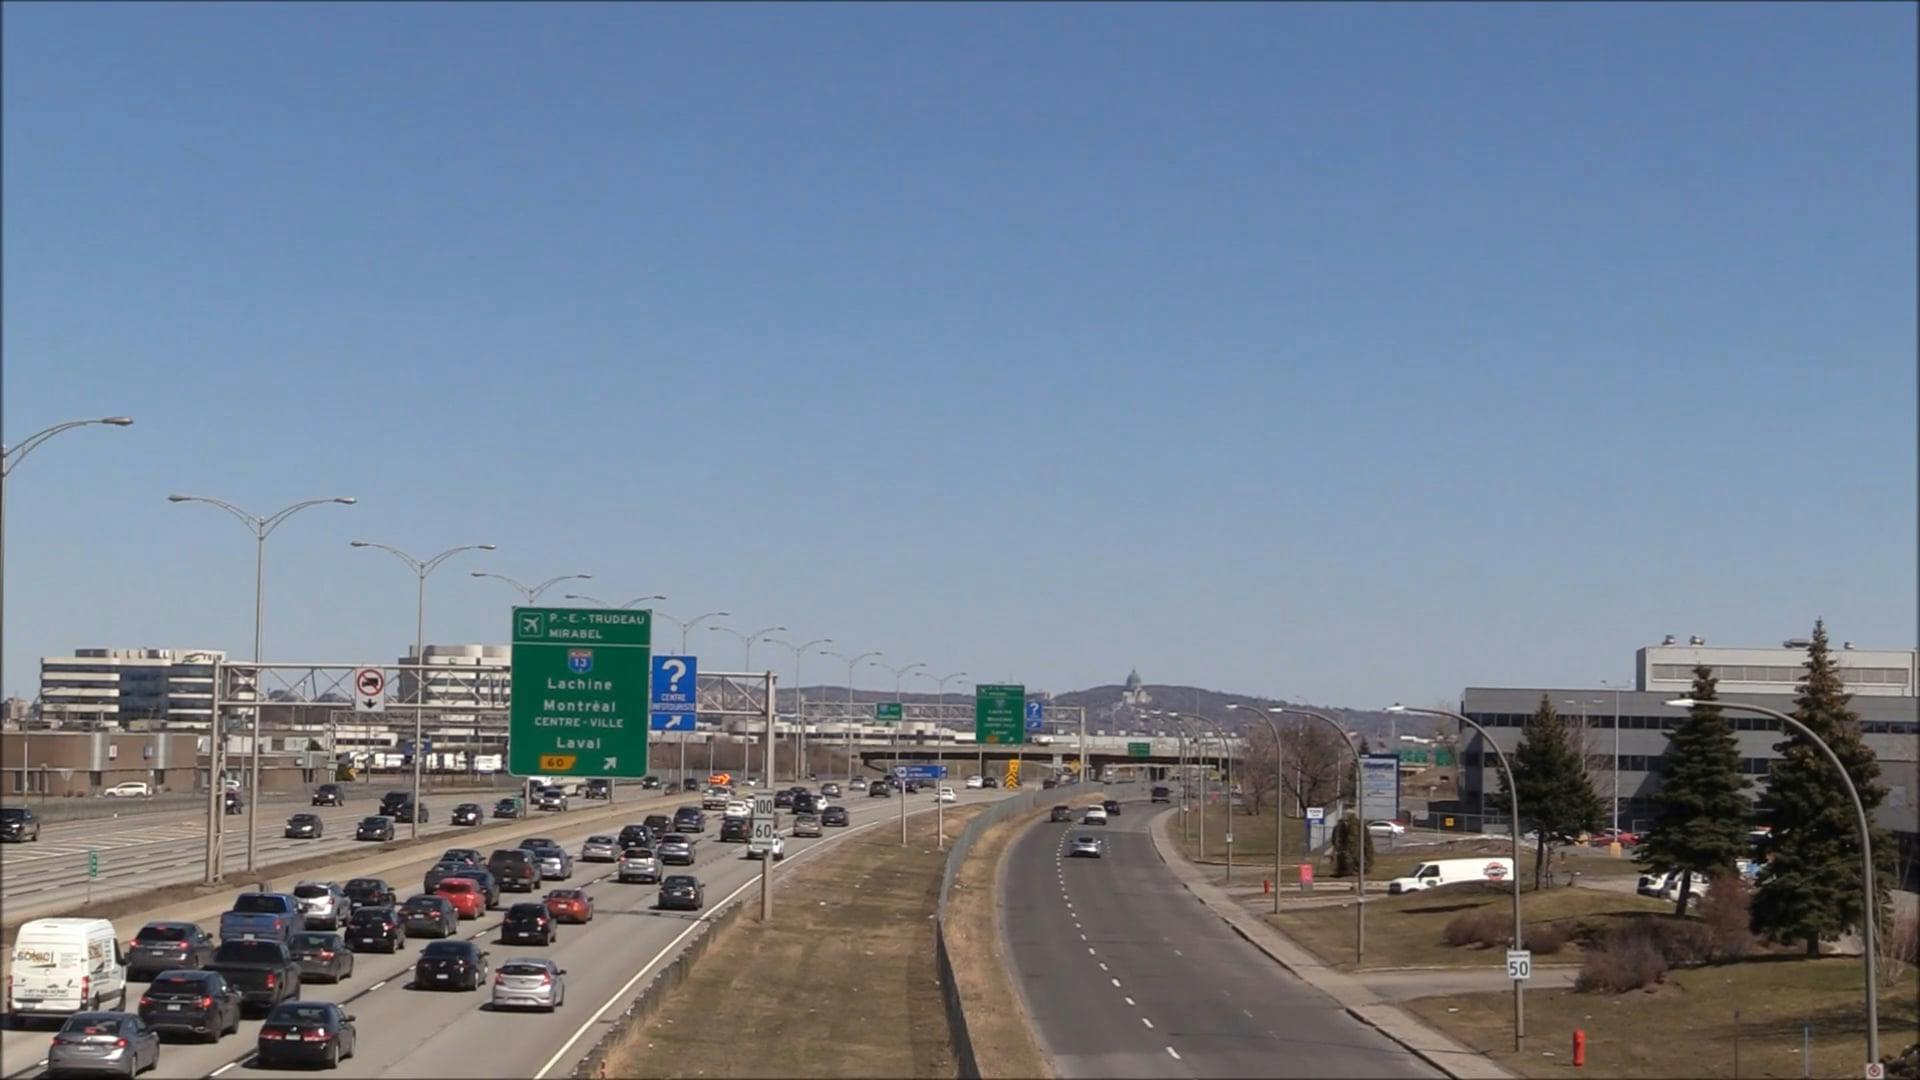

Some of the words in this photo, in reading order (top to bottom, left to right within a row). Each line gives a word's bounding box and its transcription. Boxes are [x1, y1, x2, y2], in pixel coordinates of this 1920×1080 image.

[549, 629, 603, 639] MIRABEL
[574, 658, 587, 668] 13
[547, 677, 612, 690] Lachine
[543, 699, 616, 712] Montréal
[556, 737, 601, 749] Laval
[547, 758, 564, 768] 60
[755, 799, 773, 814] 100
[755, 824, 772, 838] 60
[1510, 960, 1529, 977] 50
